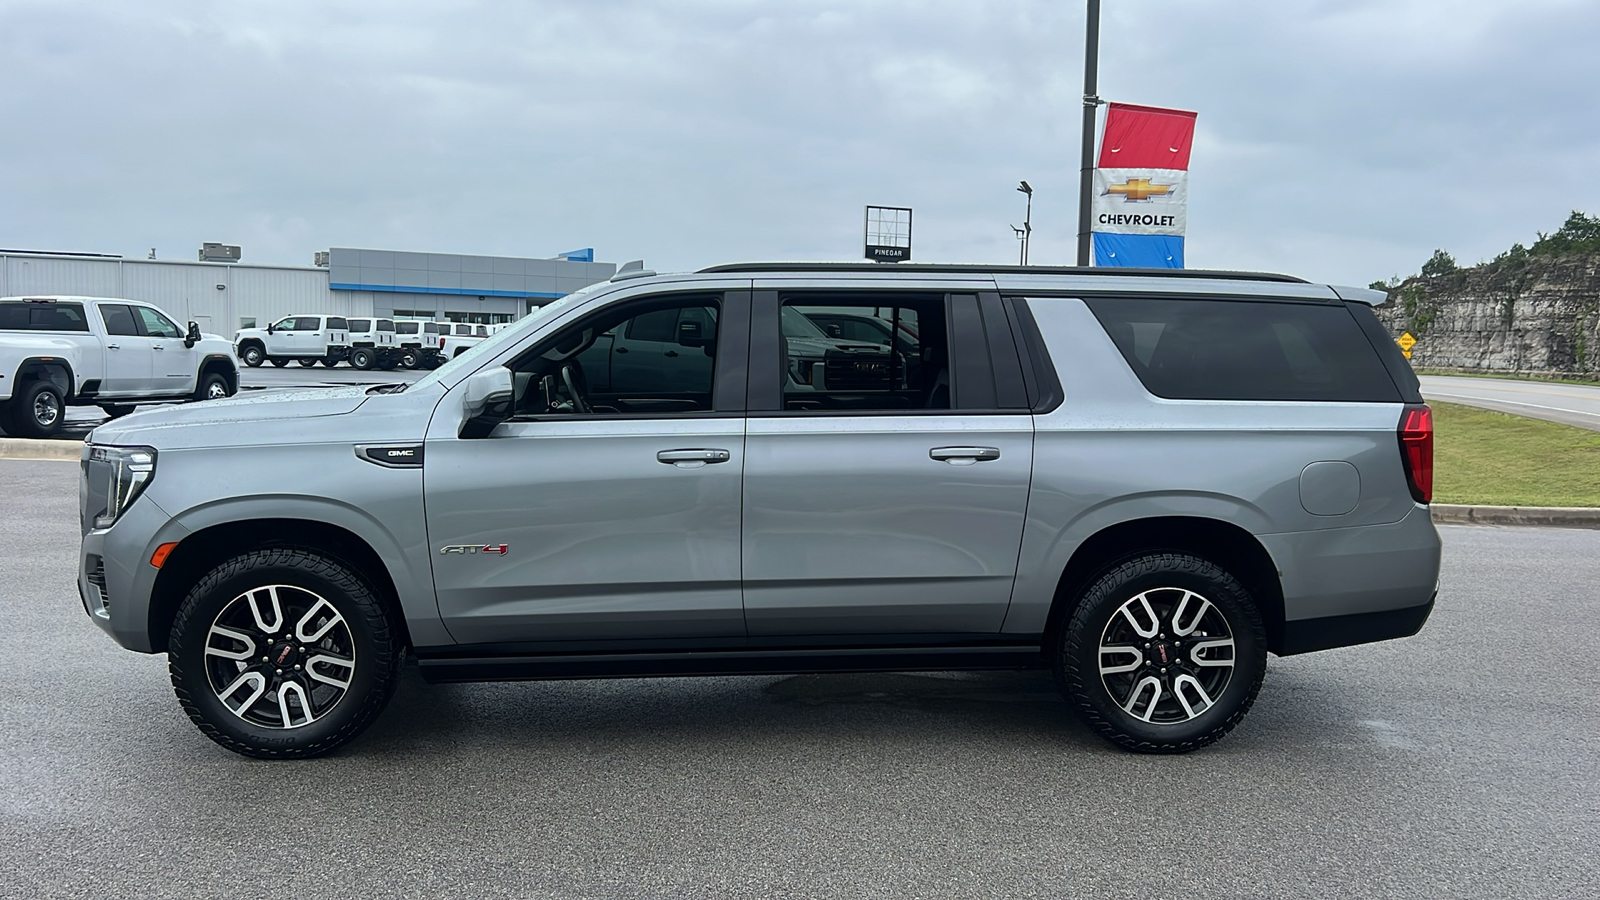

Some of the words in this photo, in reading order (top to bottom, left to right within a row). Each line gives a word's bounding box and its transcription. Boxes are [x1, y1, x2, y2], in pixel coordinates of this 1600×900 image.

[1099, 213, 1175, 226] CHEVROLET
[874, 248, 903, 257] PINEGAR
[440, 543, 508, 557] AT4
